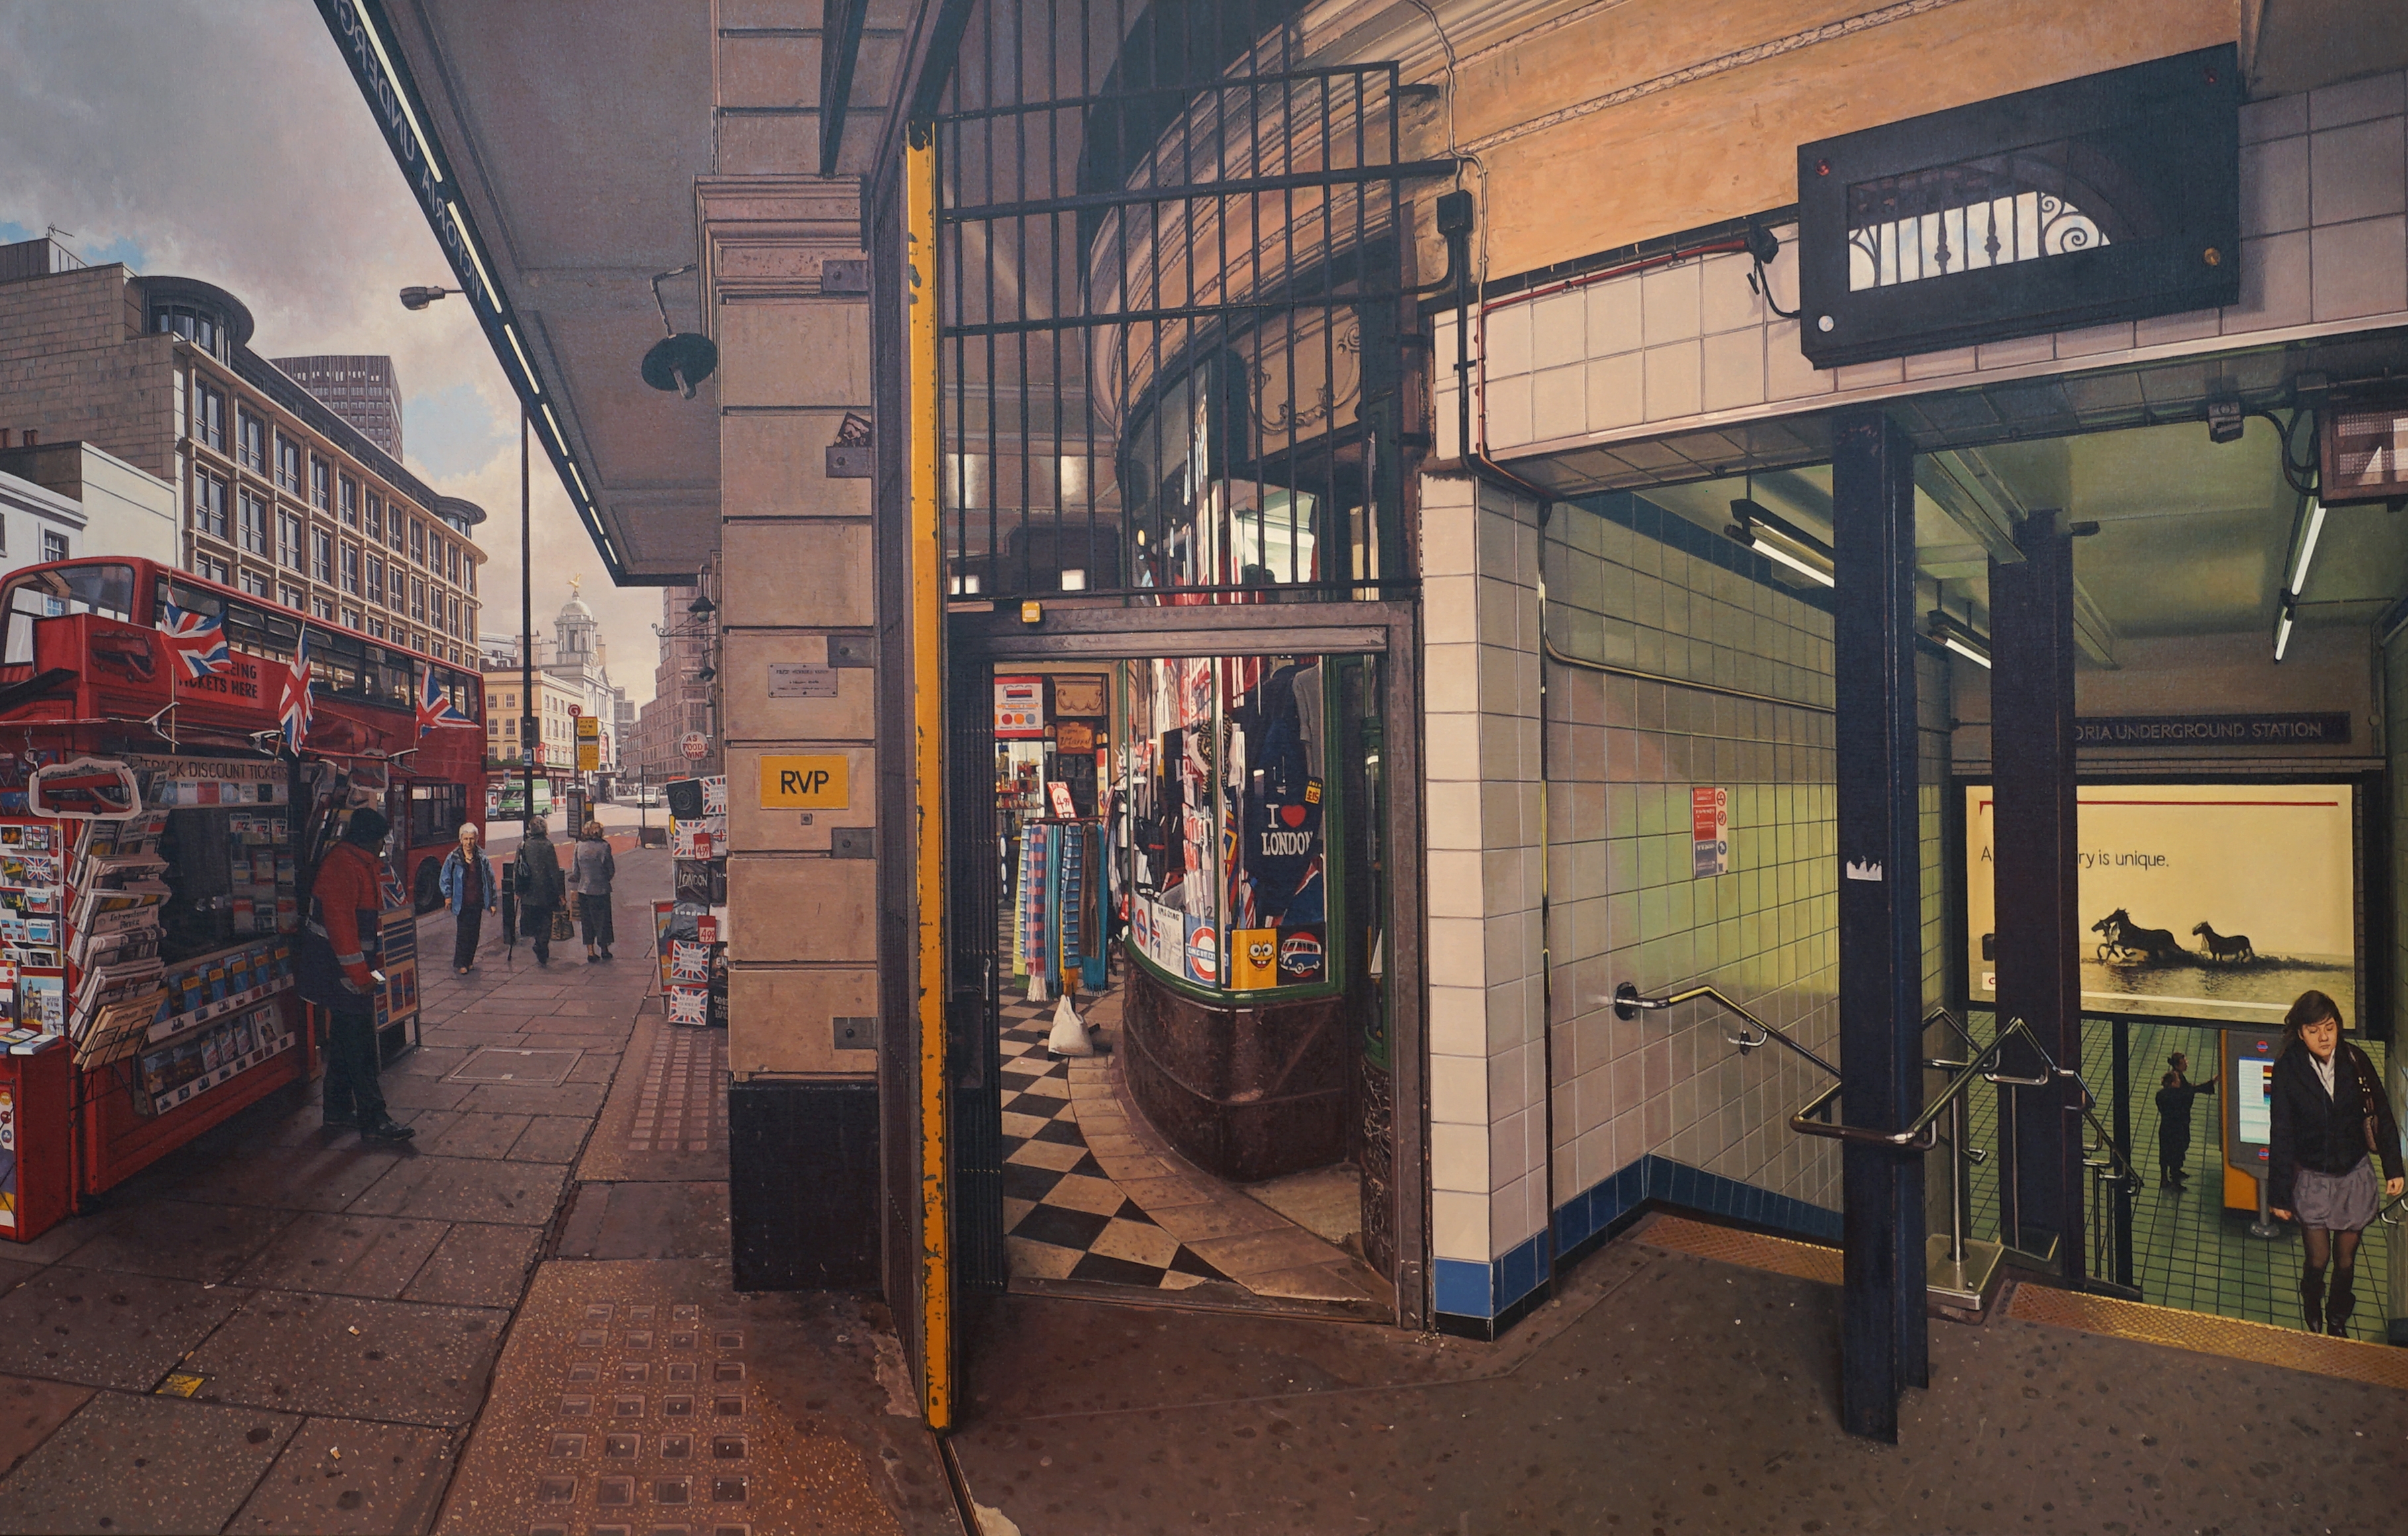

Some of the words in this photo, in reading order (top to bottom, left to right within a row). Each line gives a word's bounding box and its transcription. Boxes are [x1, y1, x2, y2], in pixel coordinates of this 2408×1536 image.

[231, 683, 258, 698] HERE
[2117, 723, 2244, 740] UNDERGROUND
[2252, 722, 2322, 738] STATION
[189, 762, 245, 779] DISCOUNT
[250, 763, 288, 780] TICKETS
[781, 770, 829, 794] RVP
[1266, 803, 1279, 828] I
[2078, 851, 2095, 869] ry
[2098, 849, 2110, 865] is
[2115, 850, 2170, 871] unique.
[677, 869, 708, 888] LONDON
